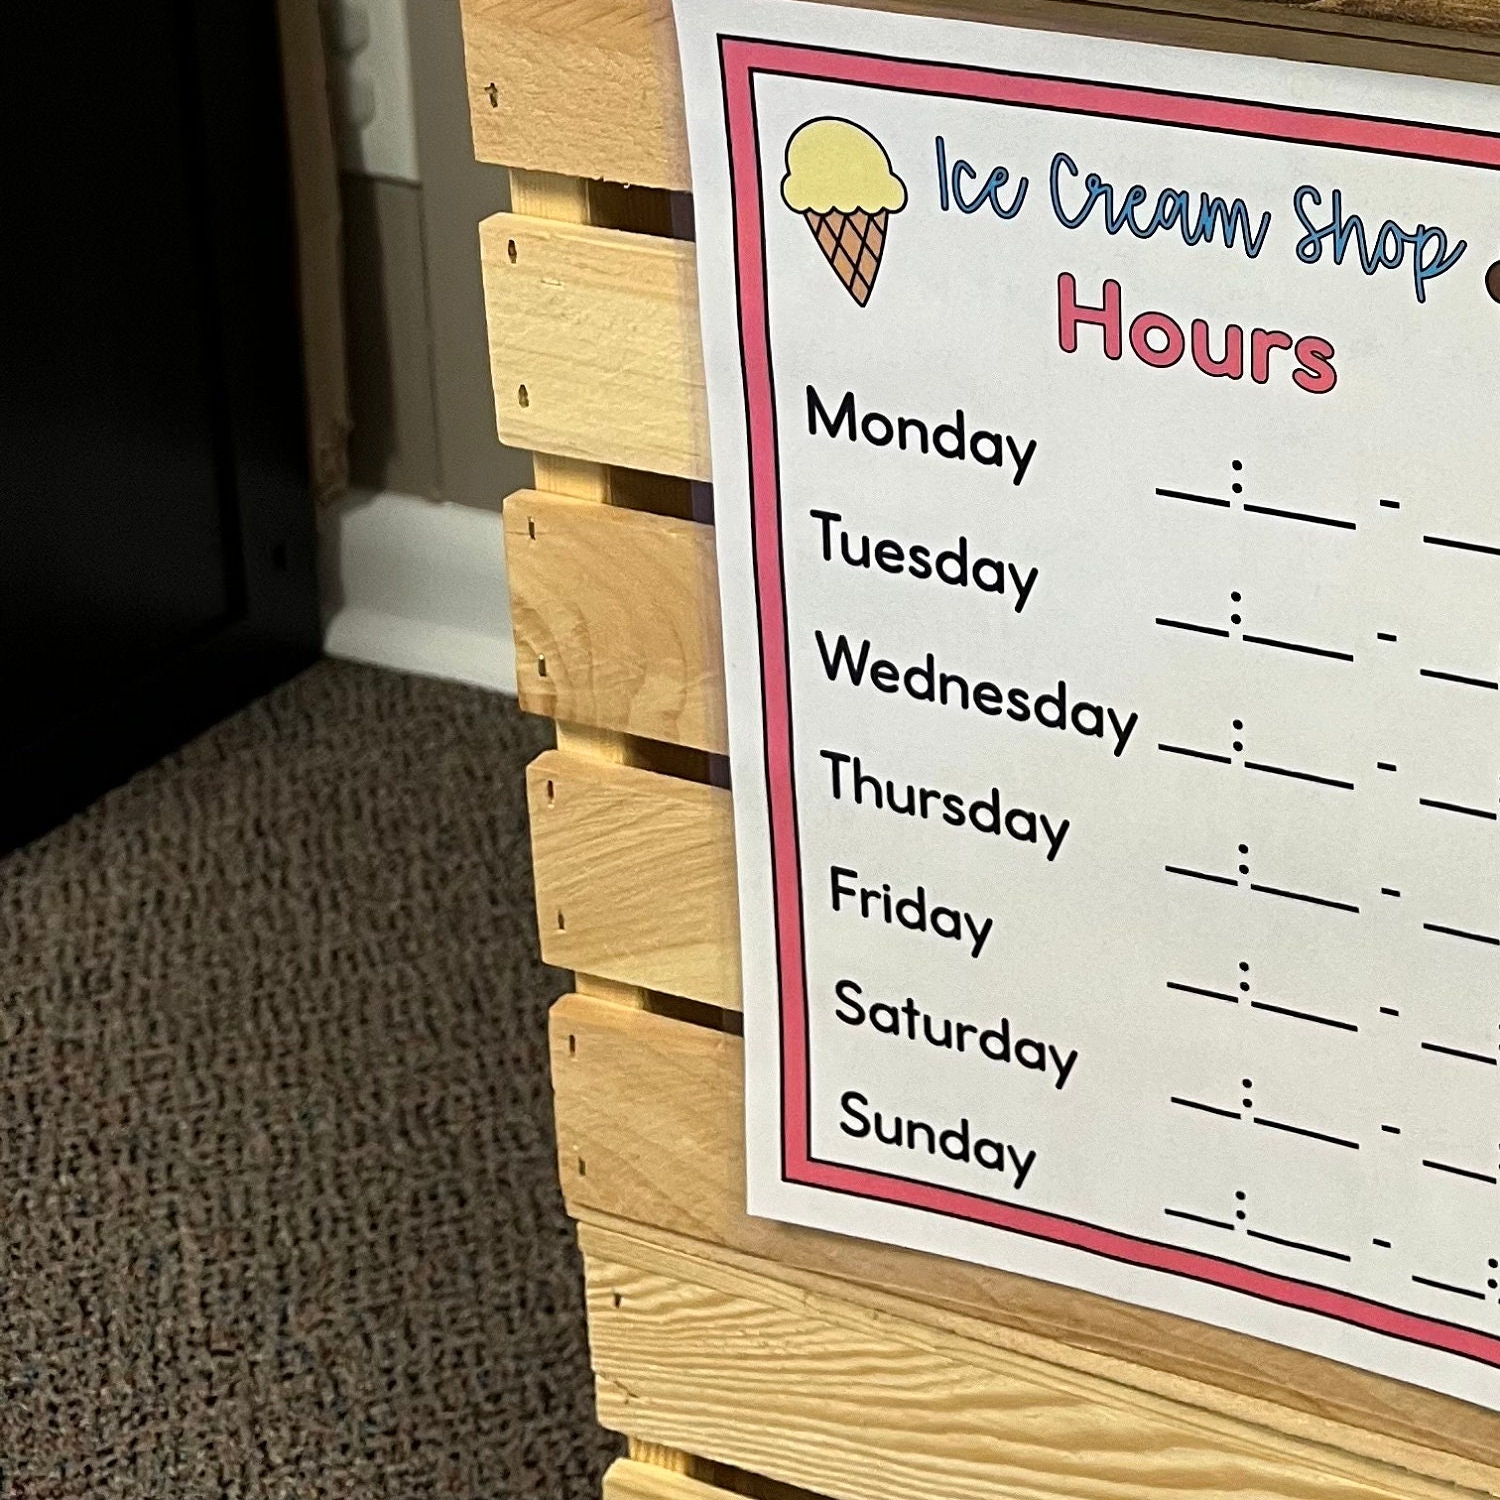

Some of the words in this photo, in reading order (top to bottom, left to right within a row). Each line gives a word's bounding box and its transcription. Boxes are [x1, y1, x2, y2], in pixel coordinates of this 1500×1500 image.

[936, 136, 1029, 219] Ice
[1050, 153, 1271, 258] Cream
[1294, 185, 1467, 303] Shop
[1058, 272, 1337, 394] Hours
[806, 385, 1036, 486] Monday
[810, 510, 1038, 613] Tuesday
[815, 630, 1138, 759] Wednesday
[820, 750, 1069, 861] Thursday
[831, 866, 992, 958] Friday
[836, 980, 1077, 1089] Saturday
[839, 1091, 1036, 1192] Sunday
